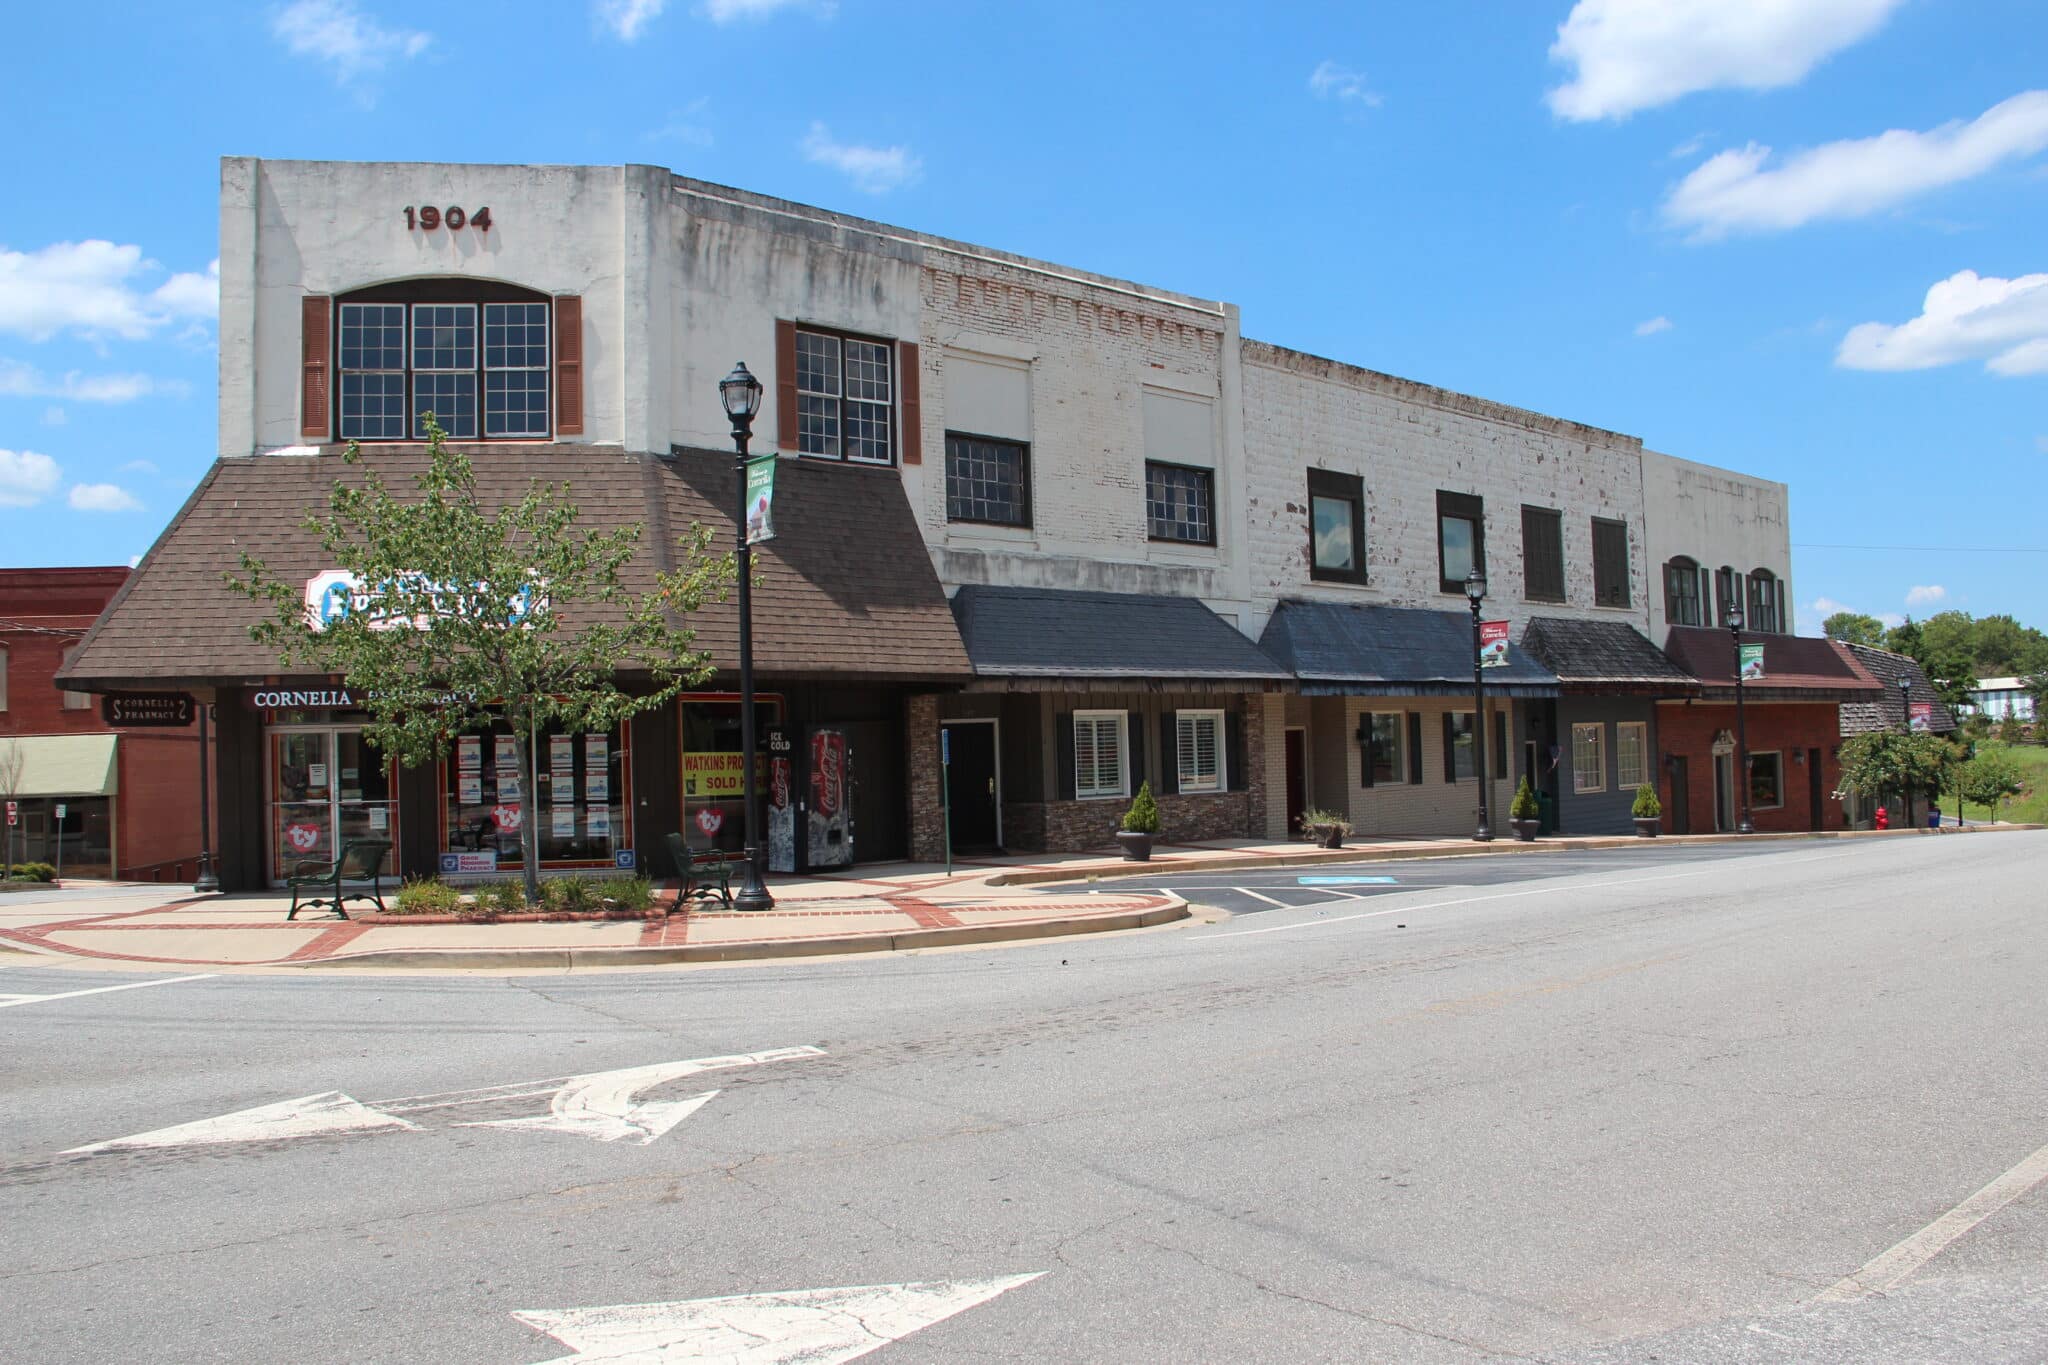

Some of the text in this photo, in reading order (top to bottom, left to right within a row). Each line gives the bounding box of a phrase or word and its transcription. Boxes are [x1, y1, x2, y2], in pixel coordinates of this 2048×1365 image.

[403, 205, 492, 232] 1904
[123, 699, 175, 708] CORNELIA
[254, 690, 352, 707] CORNELIA
[125, 711, 175, 720] PHARMACY
[770, 732, 782, 740] ICE
[770, 741, 790, 750] COLD
[685, 755, 725, 771] WATKINS
[706, 776, 737, 789] SOLD
[698, 810, 721, 832] ty
[289, 825, 318, 848] ty
